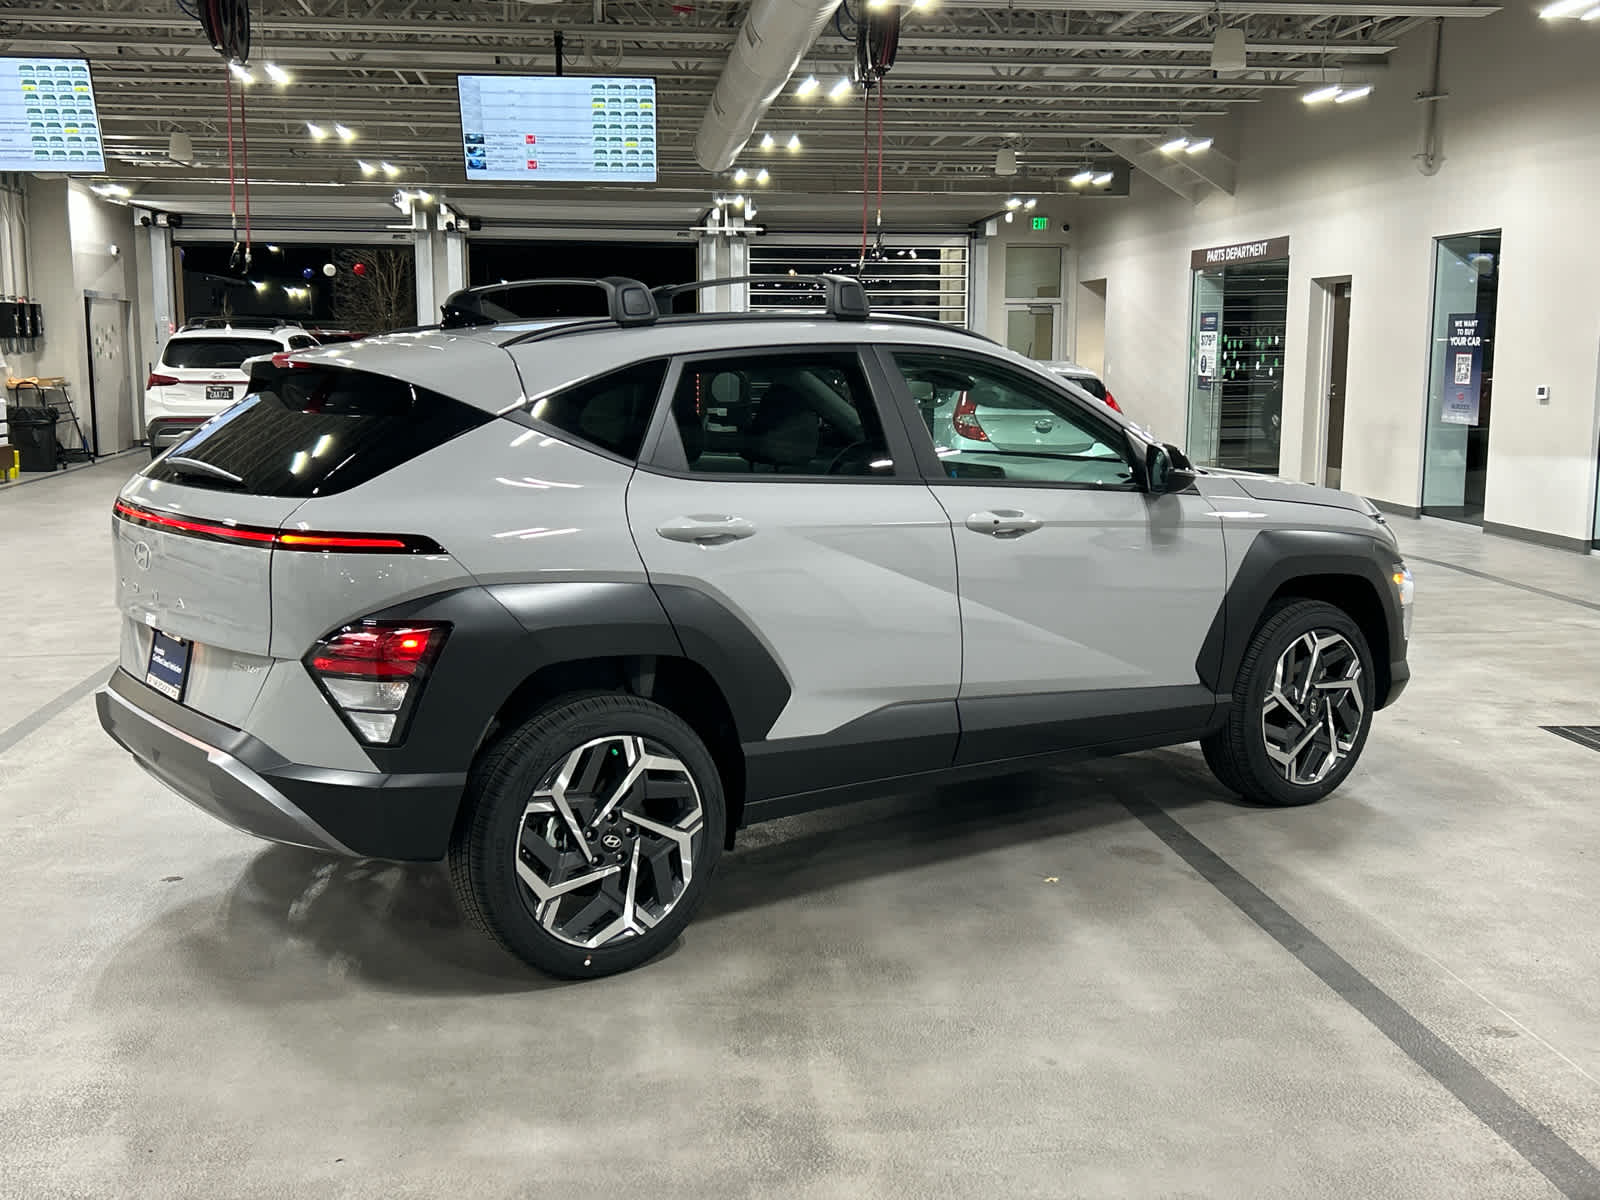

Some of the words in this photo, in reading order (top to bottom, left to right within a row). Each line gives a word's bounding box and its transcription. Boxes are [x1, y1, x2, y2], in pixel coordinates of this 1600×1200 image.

[1033, 217, 1047, 229] EXIT
[1206, 249, 1225, 262] PARTS
[1226, 243, 1268, 260] DEPARTMENT
[1450, 336, 1466, 346] YOUR
[1467, 336, 1480, 346] CAR
